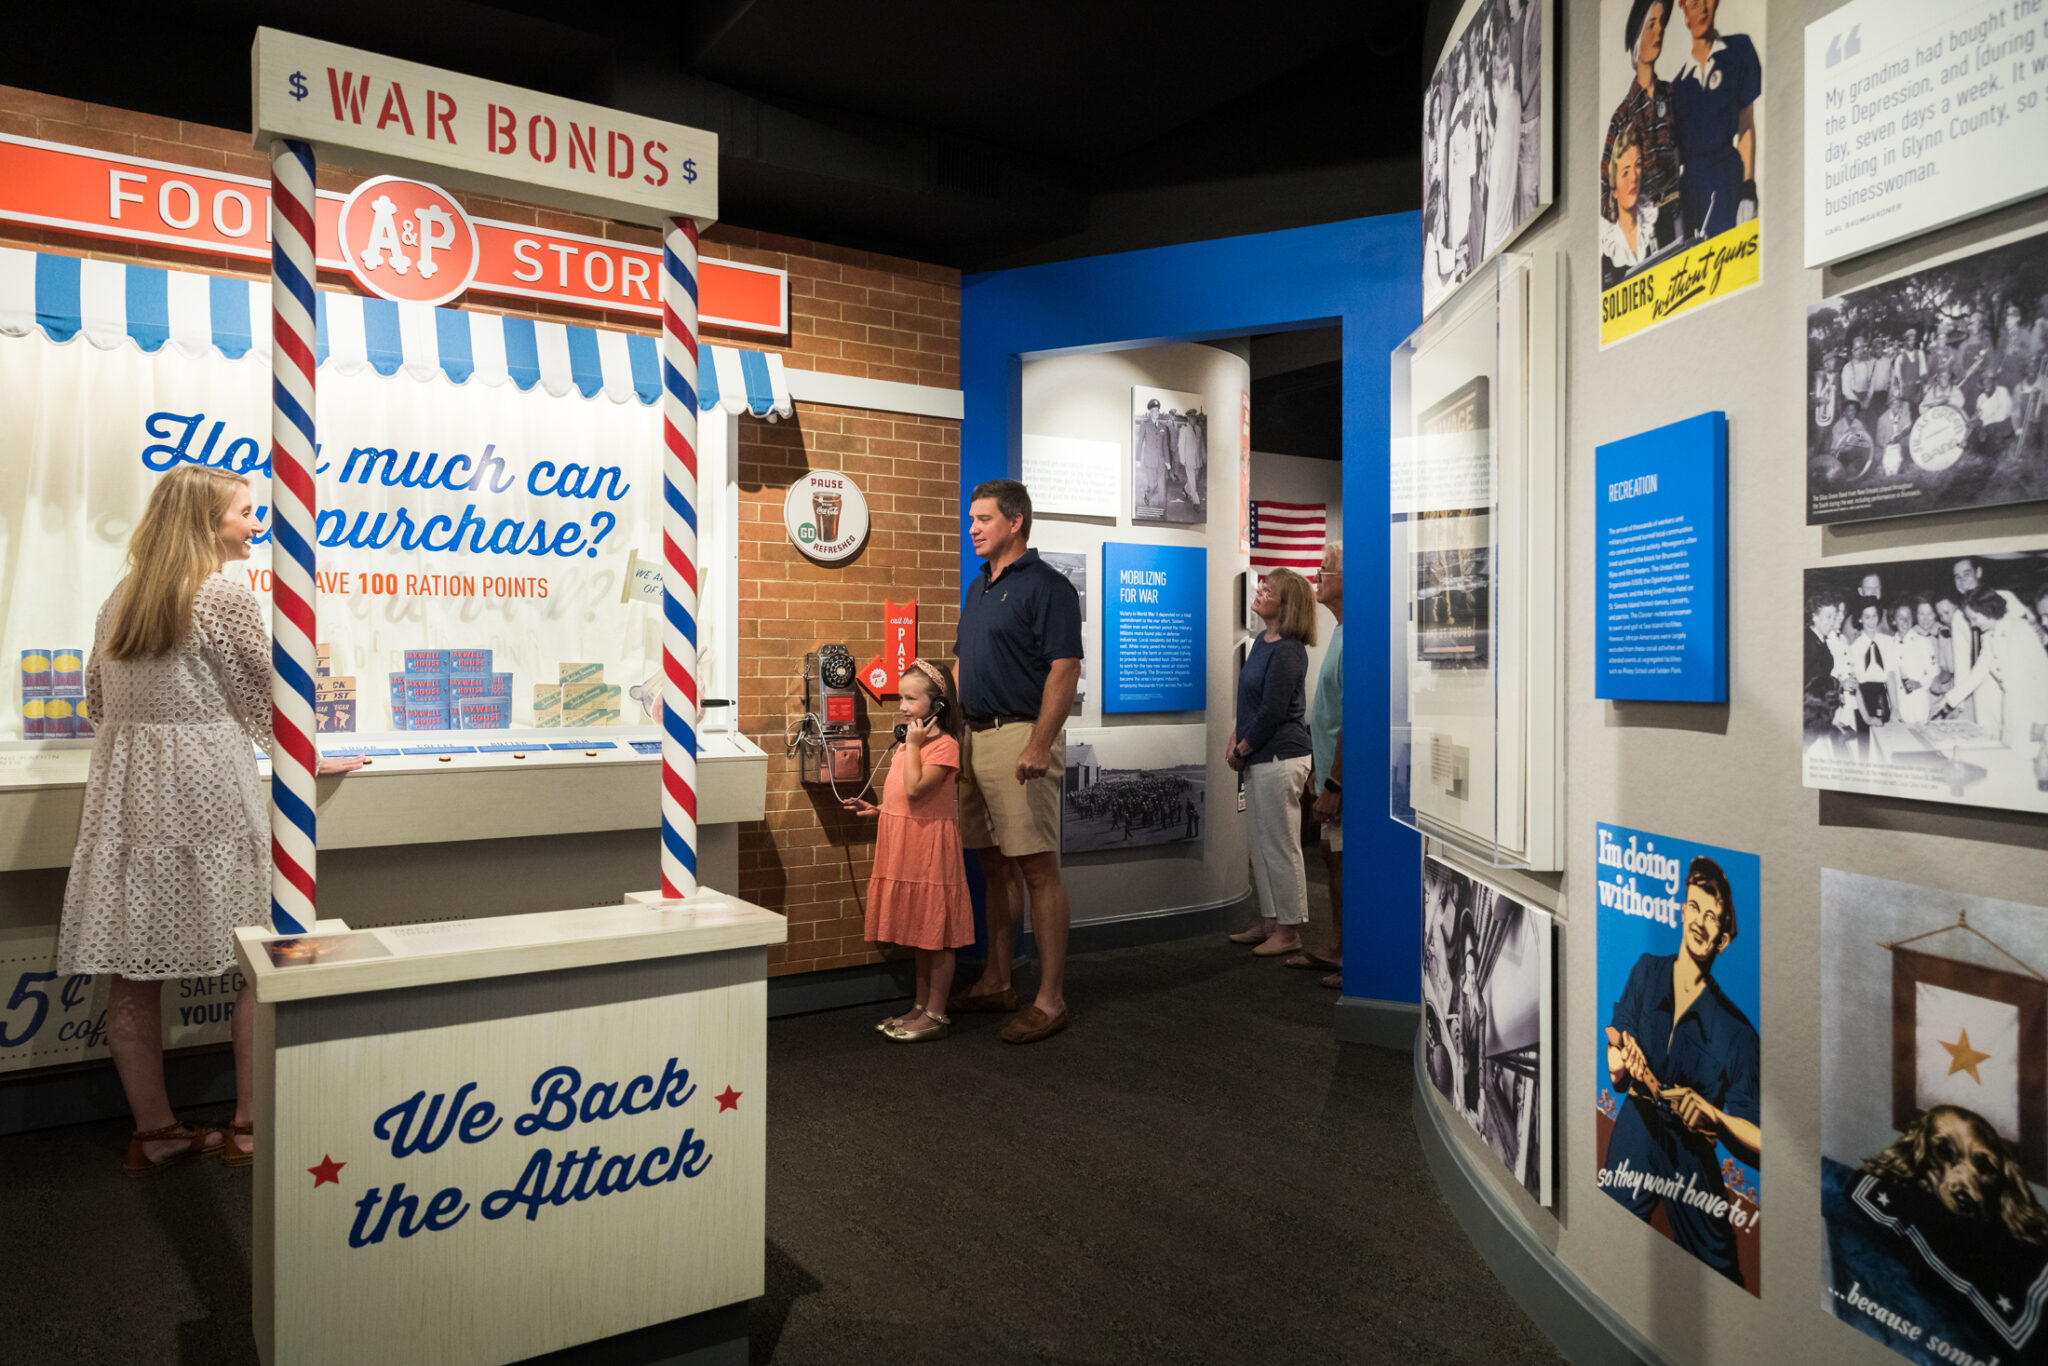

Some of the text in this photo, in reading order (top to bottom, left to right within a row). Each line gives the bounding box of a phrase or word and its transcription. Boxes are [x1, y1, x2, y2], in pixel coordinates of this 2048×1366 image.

[1825, 88, 1844, 110] My
[1850, 57, 1909, 103] grandma
[1916, 36, 1943, 67] had
[1950, 8, 2006, 52] bought
[2013, 0, 2041, 22] the
[1825, 116, 1846, 136] the
[1941, 55, 1969, 86] and
[1856, 121, 1896, 150] seven
[1902, 103, 1935, 131] days
[1942, 97, 1951, 114] a
[2012, 62, 2025, 83] It
[326, 67, 457, 145] WAR
[488, 103, 669, 187] BONDS
[1825, 156, 1877, 190] building
[1883, 147, 1896, 167] in
[1902, 129, 1943, 159] Glynn
[2017, 90, 2038, 113] so
[109, 169, 664, 302] FOO A&P STOR
[1602, 234, 1759, 323] SOLDIERS without guns
[339, 444, 515, 494] much
[527, 460, 631, 501] can
[810, 478, 844, 489] PAUSE
[1608, 473, 1658, 503] RECREATION
[316, 504, 616, 558] purchase?
[800, 527, 815, 538] GO
[813, 535, 856, 554] REFRESHED
[247, 569, 548, 598] YO AVE 100 RATION POINTS
[635, 568, 652, 579] WE
[643, 584, 658, 594] OF
[1120, 569, 1167, 587] MOBILIZING
[1120, 588, 1159, 604] FOR WAR
[890, 617, 902, 625] call
[471, 714, 500, 722] HOUSE
[1598, 828, 1680, 895] I'm doing
[1598, 874, 1681, 929] without
[180, 972, 244, 998] SAFEG
[373, 1057, 697, 1159] We Back
[348, 1128, 713, 1249] the Attack
[1596, 1158, 1760, 1234] so they won't have to!
